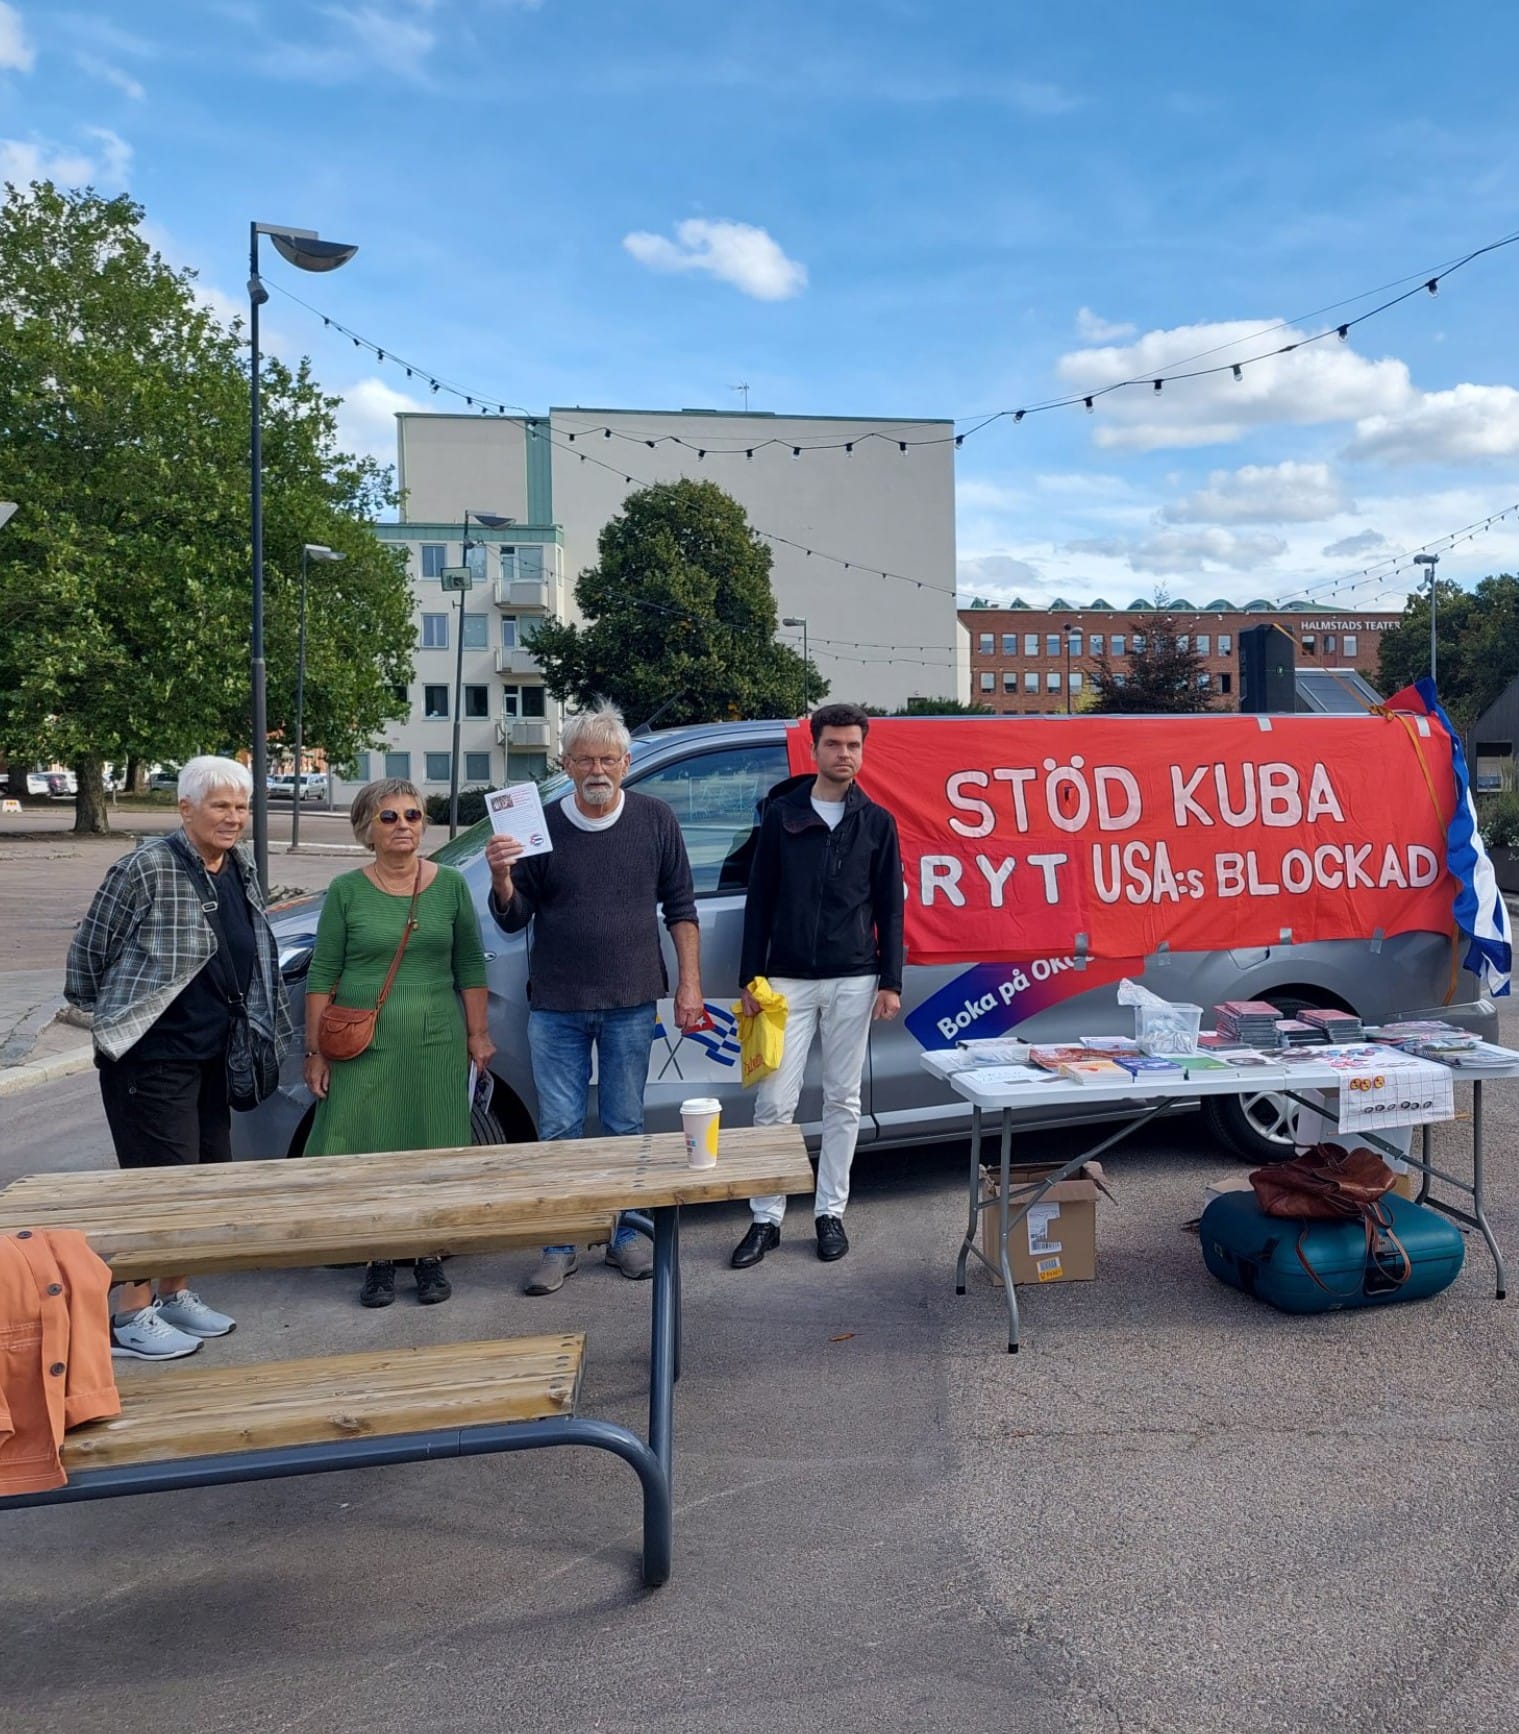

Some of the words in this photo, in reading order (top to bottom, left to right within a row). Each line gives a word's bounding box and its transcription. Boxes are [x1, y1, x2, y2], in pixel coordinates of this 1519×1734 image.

[1301, 621, 1362, 630] HALMSTADS
[1365, 621, 1401, 630] TEATER
[946, 755, 1142, 838] STÖD
[1170, 761, 1346, 828] KUBA
[901, 852, 1068, 908] RYT
[1215, 843, 1439, 898] BLOCKAD
[937, 992, 998, 1039] Boka
[998, 968, 1030, 1005] på
[1031, 956, 1095, 980] OK
